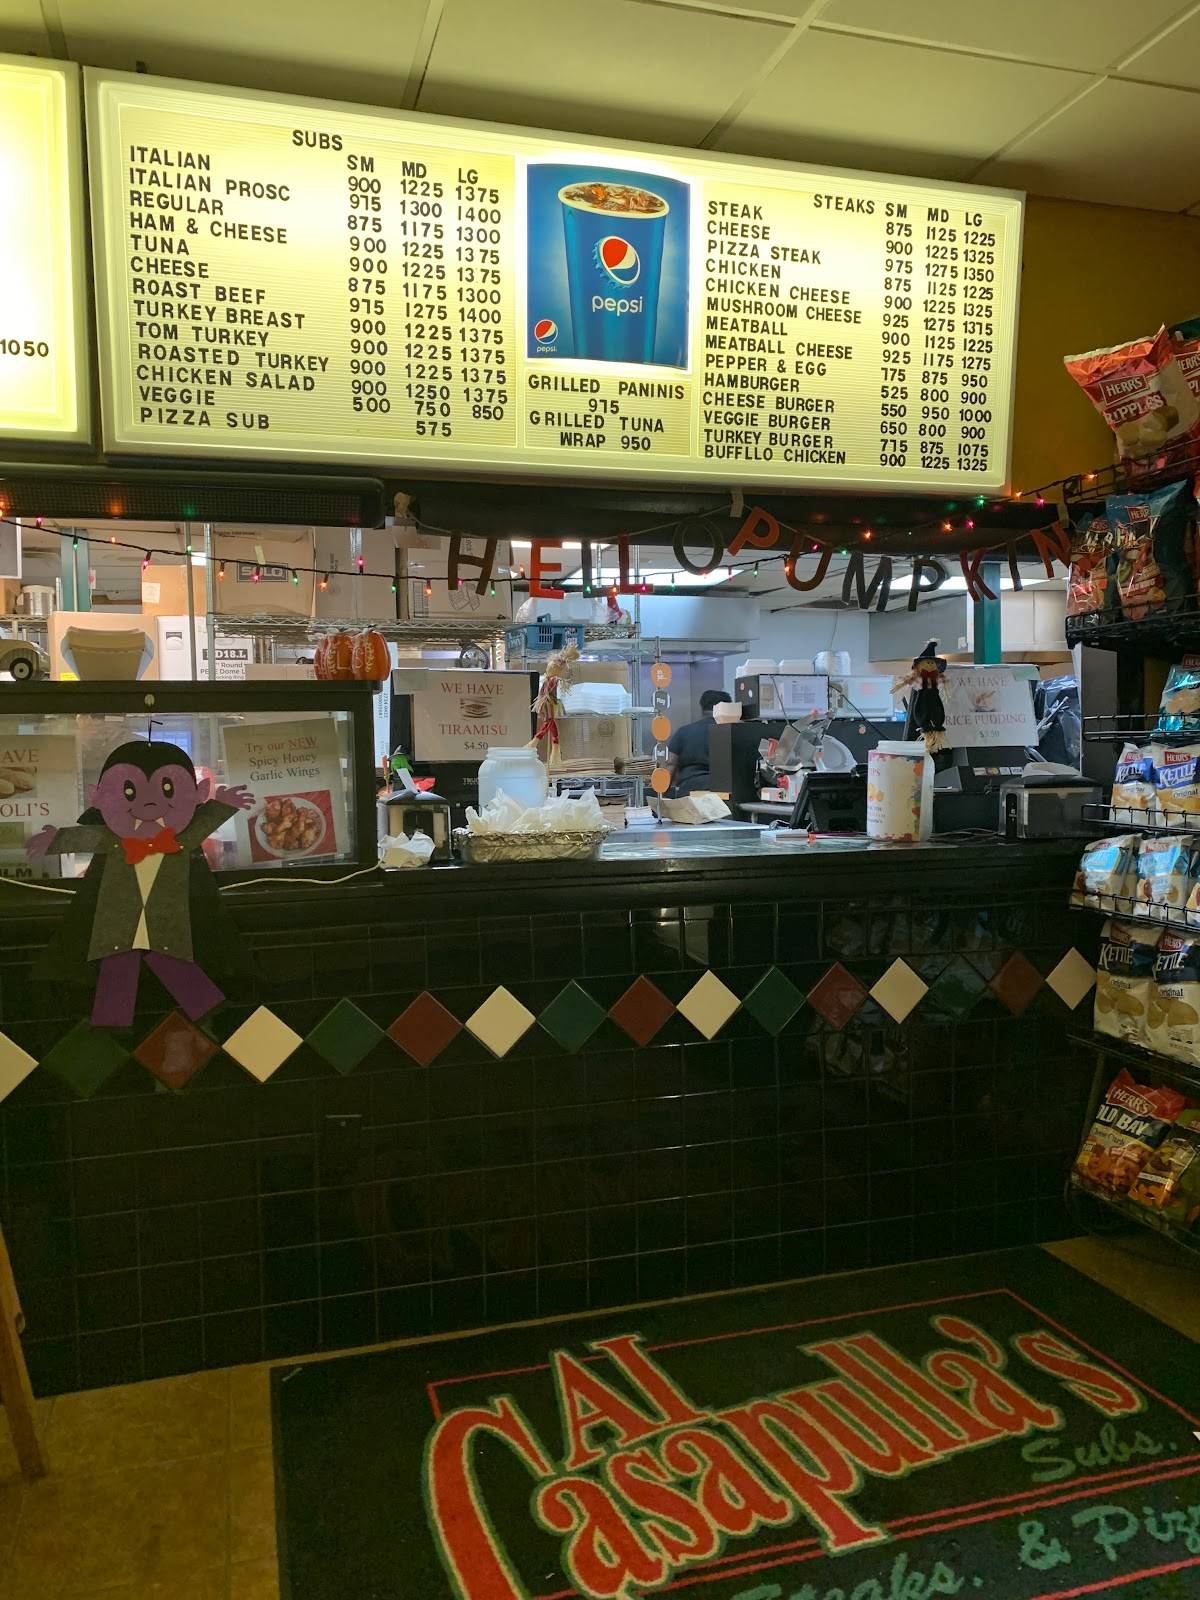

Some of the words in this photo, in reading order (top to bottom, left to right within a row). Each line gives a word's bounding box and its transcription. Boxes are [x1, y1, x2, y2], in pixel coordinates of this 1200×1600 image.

[292, 130, 342, 151] SUBS
[131, 145, 210, 171] ITALIAN
[348, 176, 381, 194] 900
[347, 155, 374, 173] SM
[402, 161, 426, 178] MD
[458, 168, 478, 184] LG
[130, 168, 211, 192] ITALIAN
[226, 179, 290, 201] PROSC
[458, 206, 501, 224] 1400
[130, 190, 223, 216] REGULAR
[347, 215, 382, 233] 875
[814, 194, 875, 214] STEAKS
[885, 203, 907, 218] SM
[927, 208, 949, 222] MD
[965, 212, 982, 227] LG
[130, 212, 174, 232] HAM
[187, 218, 198, 234] &
[210, 221, 287, 244] CHEESE
[350, 236, 386, 253] 900
[456, 247, 499, 265] 1375
[708, 201, 762, 220] STEAK
[886, 222, 912, 237] 875
[964, 231, 995, 247] 1225
[131, 234, 189, 255] TUNA
[350, 257, 387, 274] 900
[707, 220, 770, 240] CHEESE
[886, 240, 912, 255] 900
[964, 249, 994, 265] 1325
[708, 239, 759, 258] PIZZA
[771, 246, 821, 264] STEAK
[885, 259, 912, 274] 975
[964, 267, 994, 282] 1350
[131, 256, 209, 278] CHEESE
[349, 277, 385, 295] 875
[457, 287, 501, 304] 1300
[133, 278, 200, 299] ROAST
[216, 286, 265, 304] BEEF
[706, 259, 780, 279] CHICKEN
[884, 277, 911, 292] 875
[963, 285, 993, 300] 1225
[592, 296, 642, 316] pepsi
[706, 278, 779, 298] CHICKEN
[790, 286, 850, 304] CHEESE
[884, 295, 912, 310] 900
[964, 303, 992, 318] 1325
[707, 297, 797, 318] MUSHROOM
[806, 306, 860, 324] CHEESE
[883, 313, 908, 328] 925
[134, 300, 216, 322] TURKEY
[226, 308, 305, 329] BREAST
[351, 319, 385, 335] 900
[459, 328, 503, 345] 1375
[707, 316, 787, 336] MEATBALL
[882, 331, 910, 346] 900
[964, 338, 993, 353] 1225
[0, 338, 49, 358] 1050
[136, 322, 178, 340] TOM
[192, 326, 268, 347] TURKEY
[351, 339, 387, 355] 900
[706, 335, 785, 354] MEATBALL
[796, 342, 852, 359] CHEESE
[883, 349, 911, 364] 925
[962, 356, 991, 371] 1275
[139, 343, 239, 365] ROASTED
[255, 352, 328, 372] TURKEY
[350, 359, 385, 376] 900
[461, 368, 506, 384] 1375
[706, 354, 766, 371] PEPPER
[777, 359, 786, 373] &
[796, 361, 826, 376] EGG
[962, 374, 987, 388] 950
[137, 365, 231, 386] CHICKEN
[246, 372, 314, 391] SALAD
[352, 380, 386, 396] 900
[528, 375, 600, 393] GRILLED
[619, 381, 684, 399] PANINIS
[705, 373, 799, 392] HAMBURGER
[881, 386, 908, 400] 525
[961, 391, 986, 405] 900
[139, 386, 215, 405] VEGGIE
[353, 397, 390, 413] 500
[472, 405, 503, 420] 850
[703, 392, 765, 408] CHEESE
[776, 396, 834, 413] BURGER
[881, 403, 906, 417] 550
[959, 409, 992, 423] 1000
[141, 407, 210, 426] PIZZA
[227, 413, 269, 429] SUB
[416, 421, 451, 437] 575
[530, 411, 604, 429] GRILLED
[620, 417, 664, 432] TUNA
[704, 410, 758, 426] VEGGIE
[769, 414, 830, 430] BURGER
[881, 421, 907, 435] 650
[961, 426, 985, 439] 900
[561, 432, 605, 448] WRAP
[621, 436, 650, 451] 950
[704, 429, 761, 445] TURKEY
[769, 433, 832, 448] BURGER
[958, 443, 988, 457] 1075
[705, 445, 773, 461] BUFFLLO
[784, 449, 845, 464] CHICKEN
[880, 454, 906, 467] 900
[957, 458, 987, 471] 1325
[448, 516, 724, 600] HELLO
[441, 682, 463, 694] WE
[467, 683, 504, 696] HAVE
[438, 723, 508, 736] TIRAMISU
[945, 714, 972, 726] RICE
[975, 713, 1026, 726] PUDDING
[245, 742, 264, 755] Try
[288, 736, 318, 749] NEW
[249, 757, 279, 770] Spicy
[283, 753, 317, 766] Honey
[250, 770, 283, 782] Garlic
[286, 766, 320, 778] Wings
[1159, 763, 1197, 787] KETTLE
[1098, 943, 1133, 970] KETTLE
[1116, 1114, 1150, 1136] BAY
[1017, 1520, 1072, 1570] &
